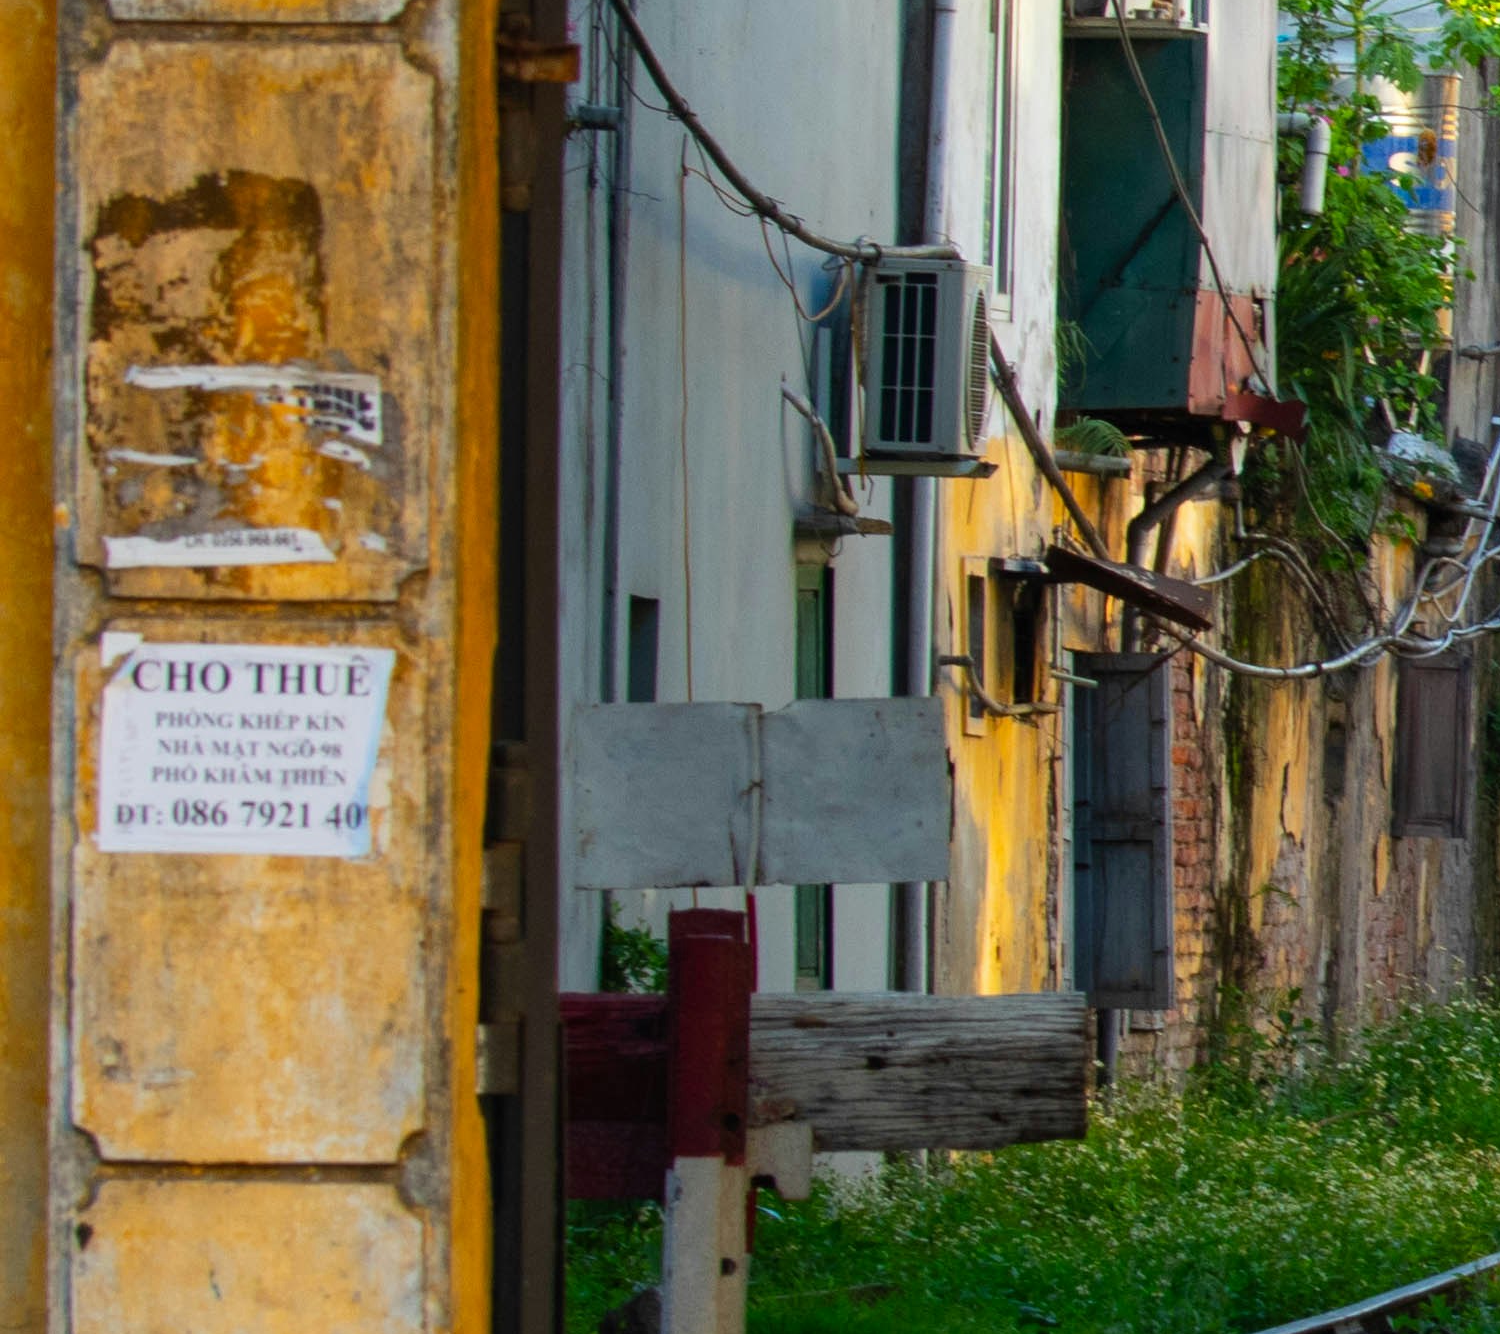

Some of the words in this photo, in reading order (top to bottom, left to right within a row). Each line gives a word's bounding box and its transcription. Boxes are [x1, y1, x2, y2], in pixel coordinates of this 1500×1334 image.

[132, 658, 233, 695] CHO
[246, 654, 373, 698] THUÊ
[172, 797, 230, 828] 086
[240, 799, 311, 829] 7921
